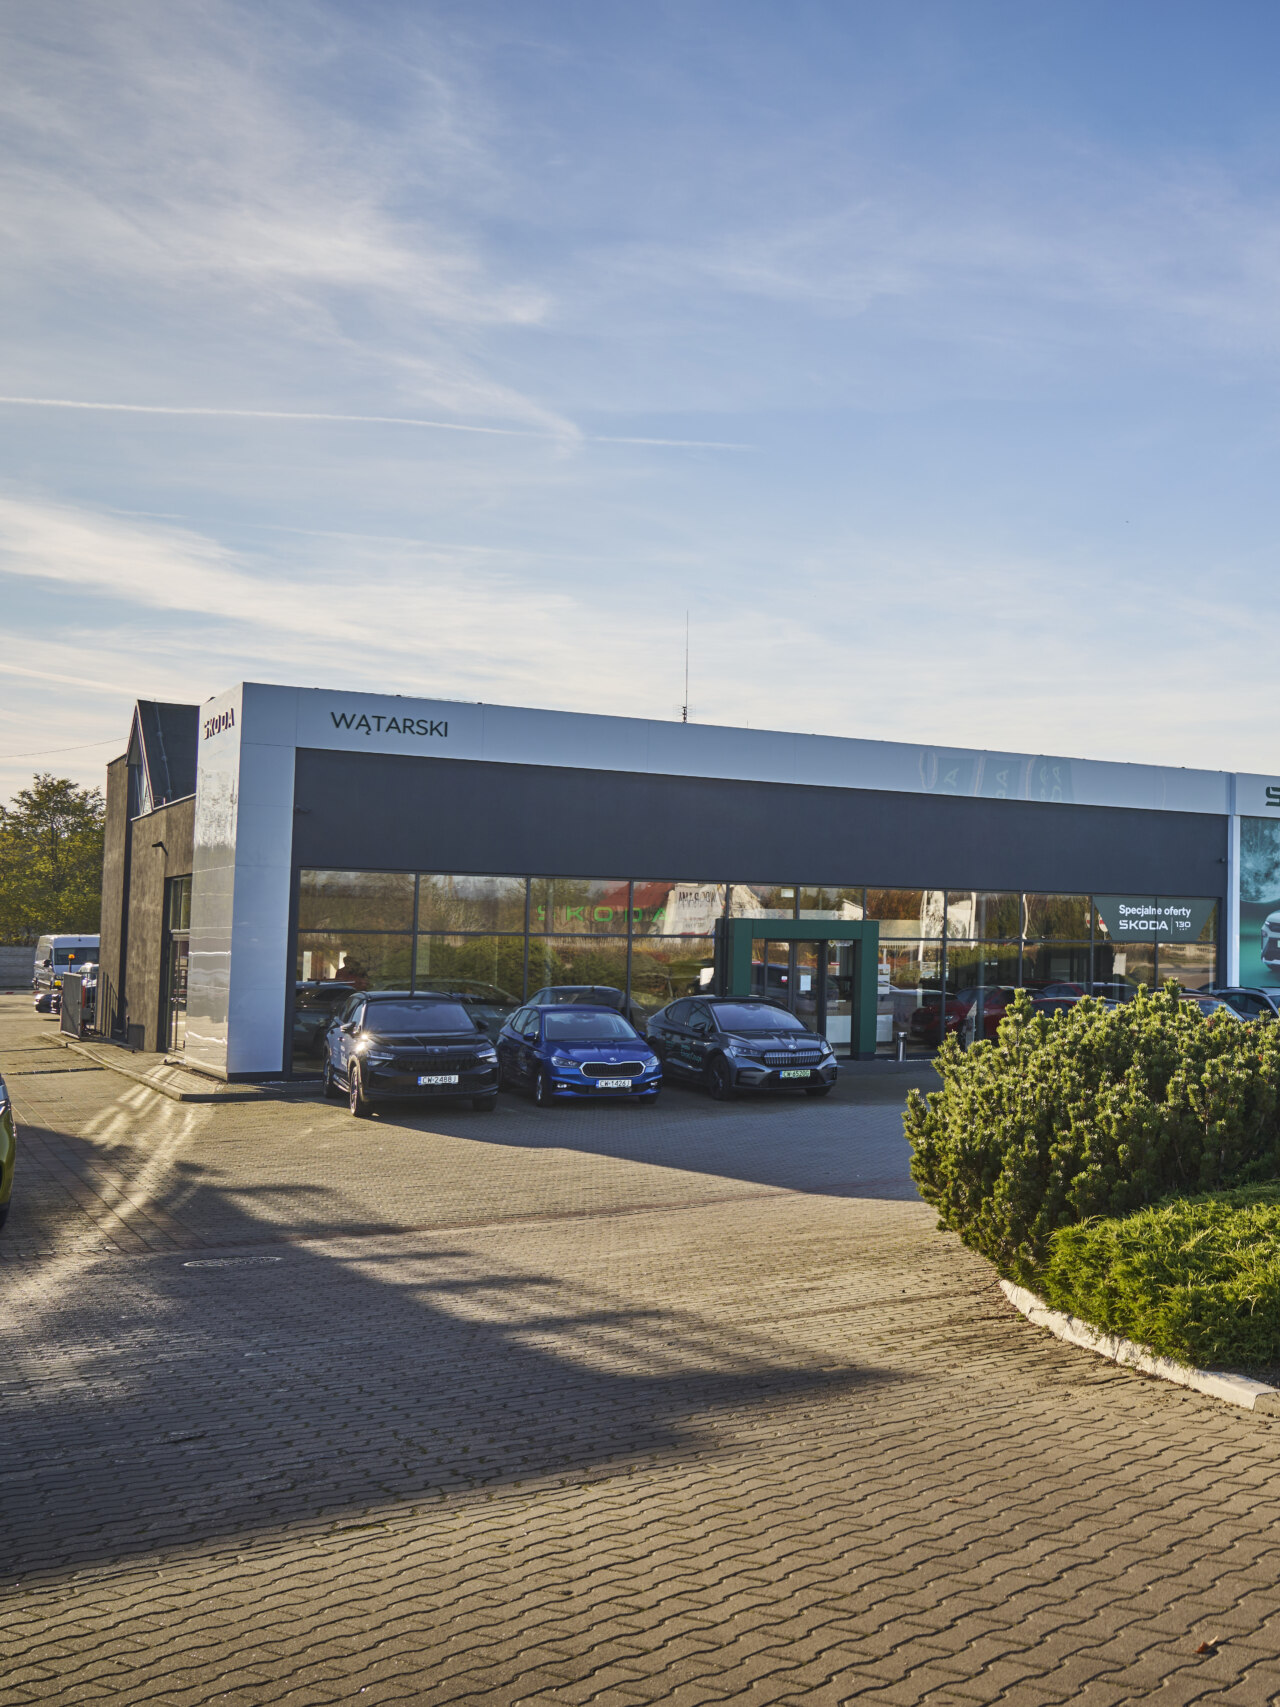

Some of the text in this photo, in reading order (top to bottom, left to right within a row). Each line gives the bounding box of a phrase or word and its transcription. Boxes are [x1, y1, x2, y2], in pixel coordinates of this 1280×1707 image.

[330, 711, 448, 737] WĄTARSKI
[1119, 904, 1192, 918] Specjalne oferty
[1175, 920, 1192, 928] 130
